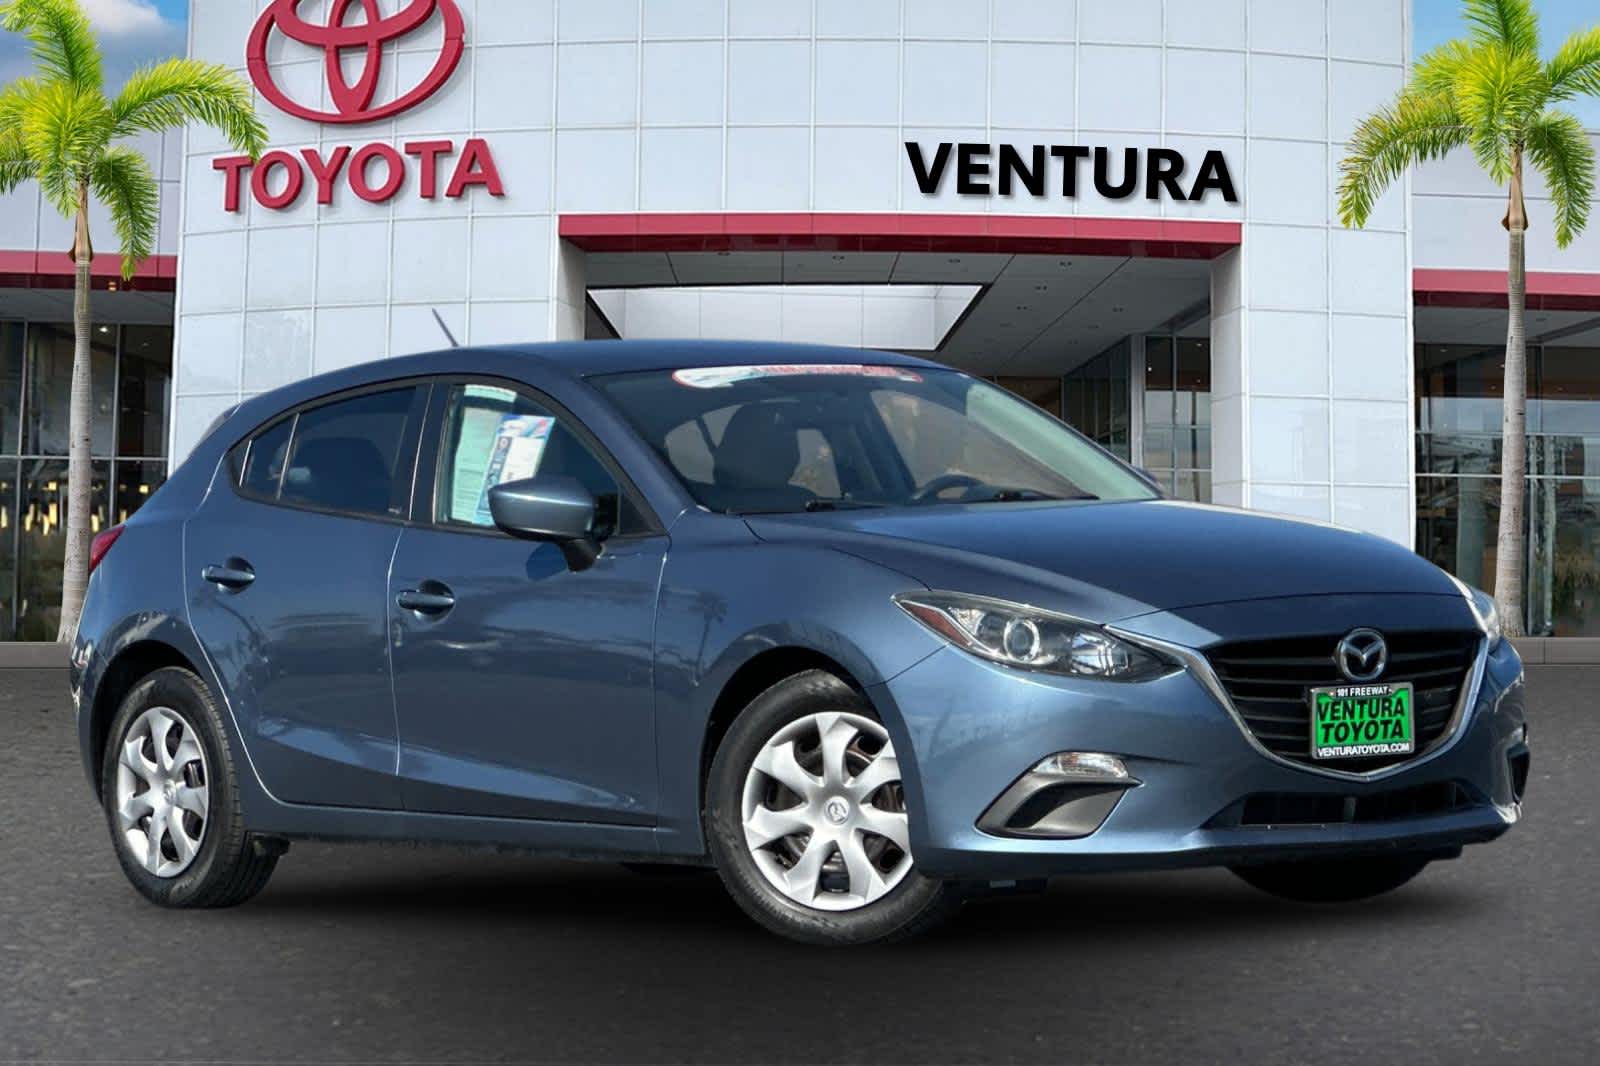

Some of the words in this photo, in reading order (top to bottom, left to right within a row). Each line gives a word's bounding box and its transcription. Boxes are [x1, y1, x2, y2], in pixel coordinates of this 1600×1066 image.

[212, 138, 505, 212] TOYOTA
[904, 142, 1239, 203] VENTURA
[1337, 688, 1349, 697] 101
[1350, 687, 1388, 697] FREEWAY
[1318, 698, 1405, 721] VENTURA
[1321, 719, 1404, 743] TOYOTA
[1318, 743, 1410, 757] VENTURATOYOTA.COM
